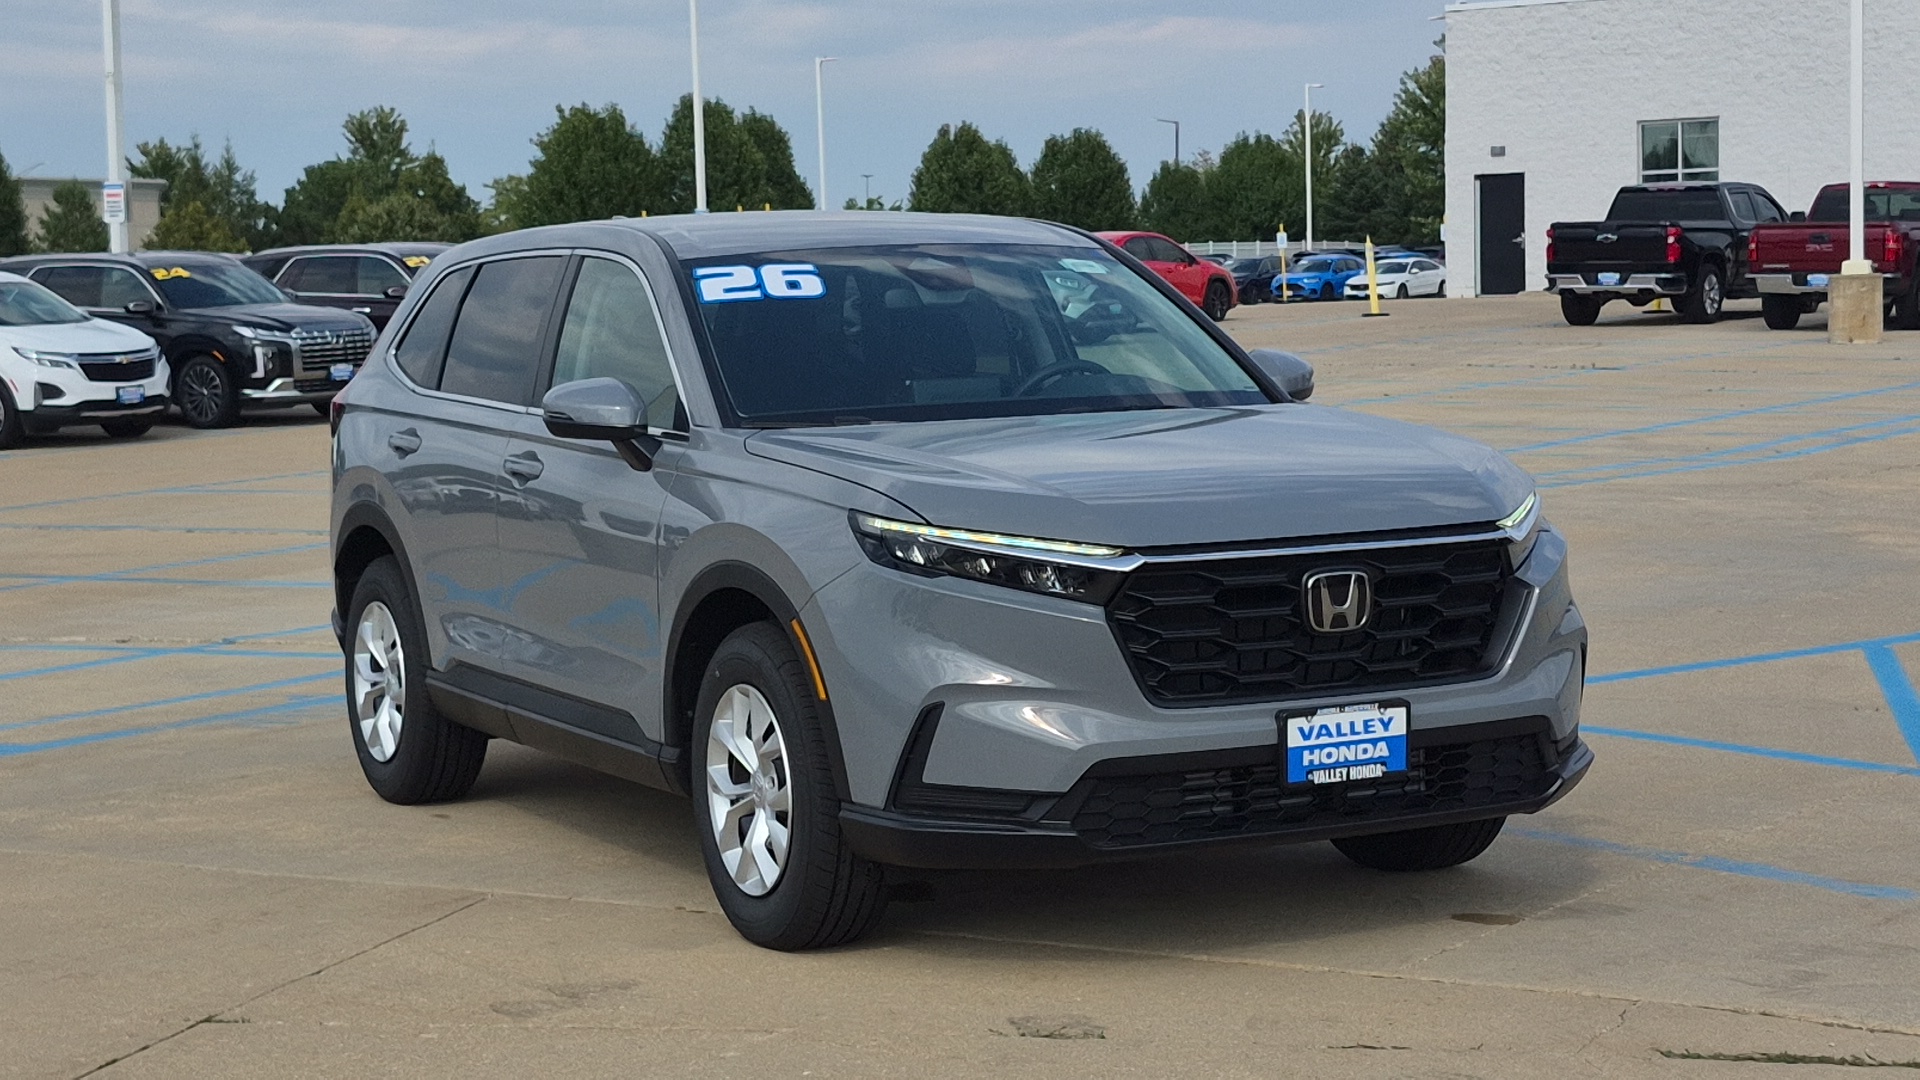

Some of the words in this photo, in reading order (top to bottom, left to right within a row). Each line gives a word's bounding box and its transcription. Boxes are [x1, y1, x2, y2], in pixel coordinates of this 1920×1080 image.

[150, 266, 192, 280] 24
[693, 263, 826, 304] 26
[1297, 716, 1394, 741] VALLEY
[1303, 741, 1389, 766] HONDA
[1313, 767, 1348, 784] VALLEY
[1349, 763, 1383, 780] HONDA
